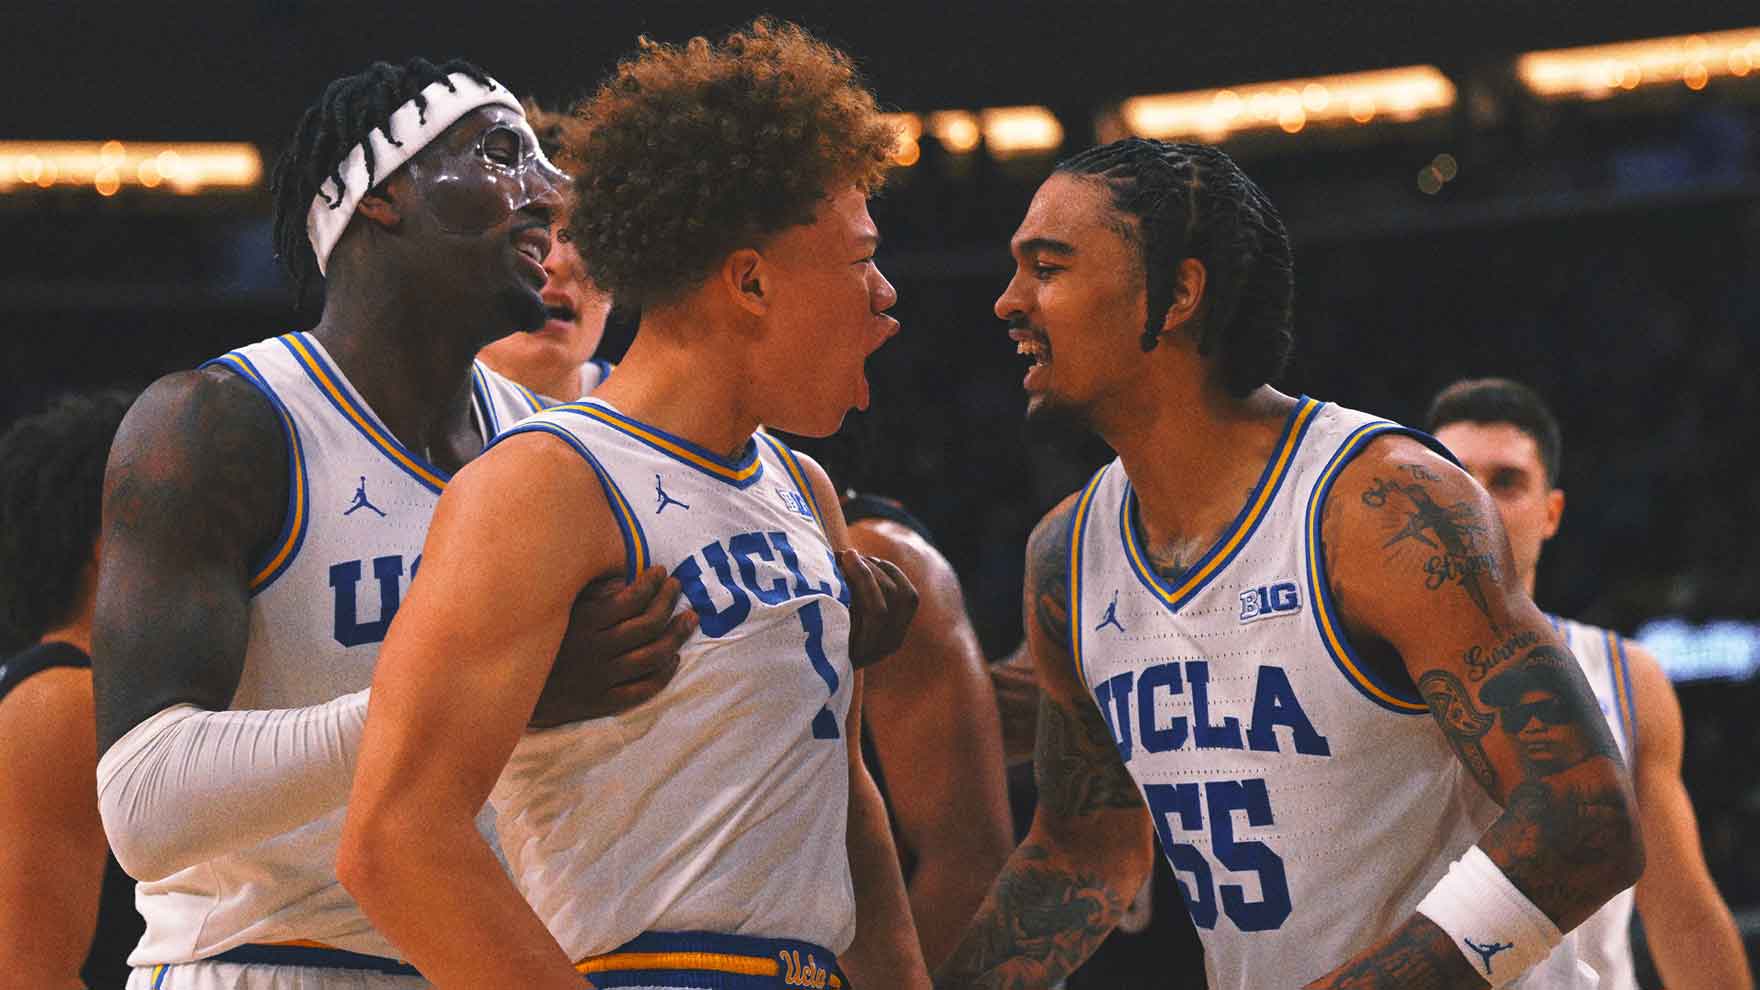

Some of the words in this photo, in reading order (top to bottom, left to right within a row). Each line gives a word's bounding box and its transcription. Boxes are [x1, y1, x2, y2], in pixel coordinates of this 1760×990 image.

[329, 553, 422, 648] U
[1094, 660, 1331, 763] UCLA
[1143, 778, 1292, 932] 55
